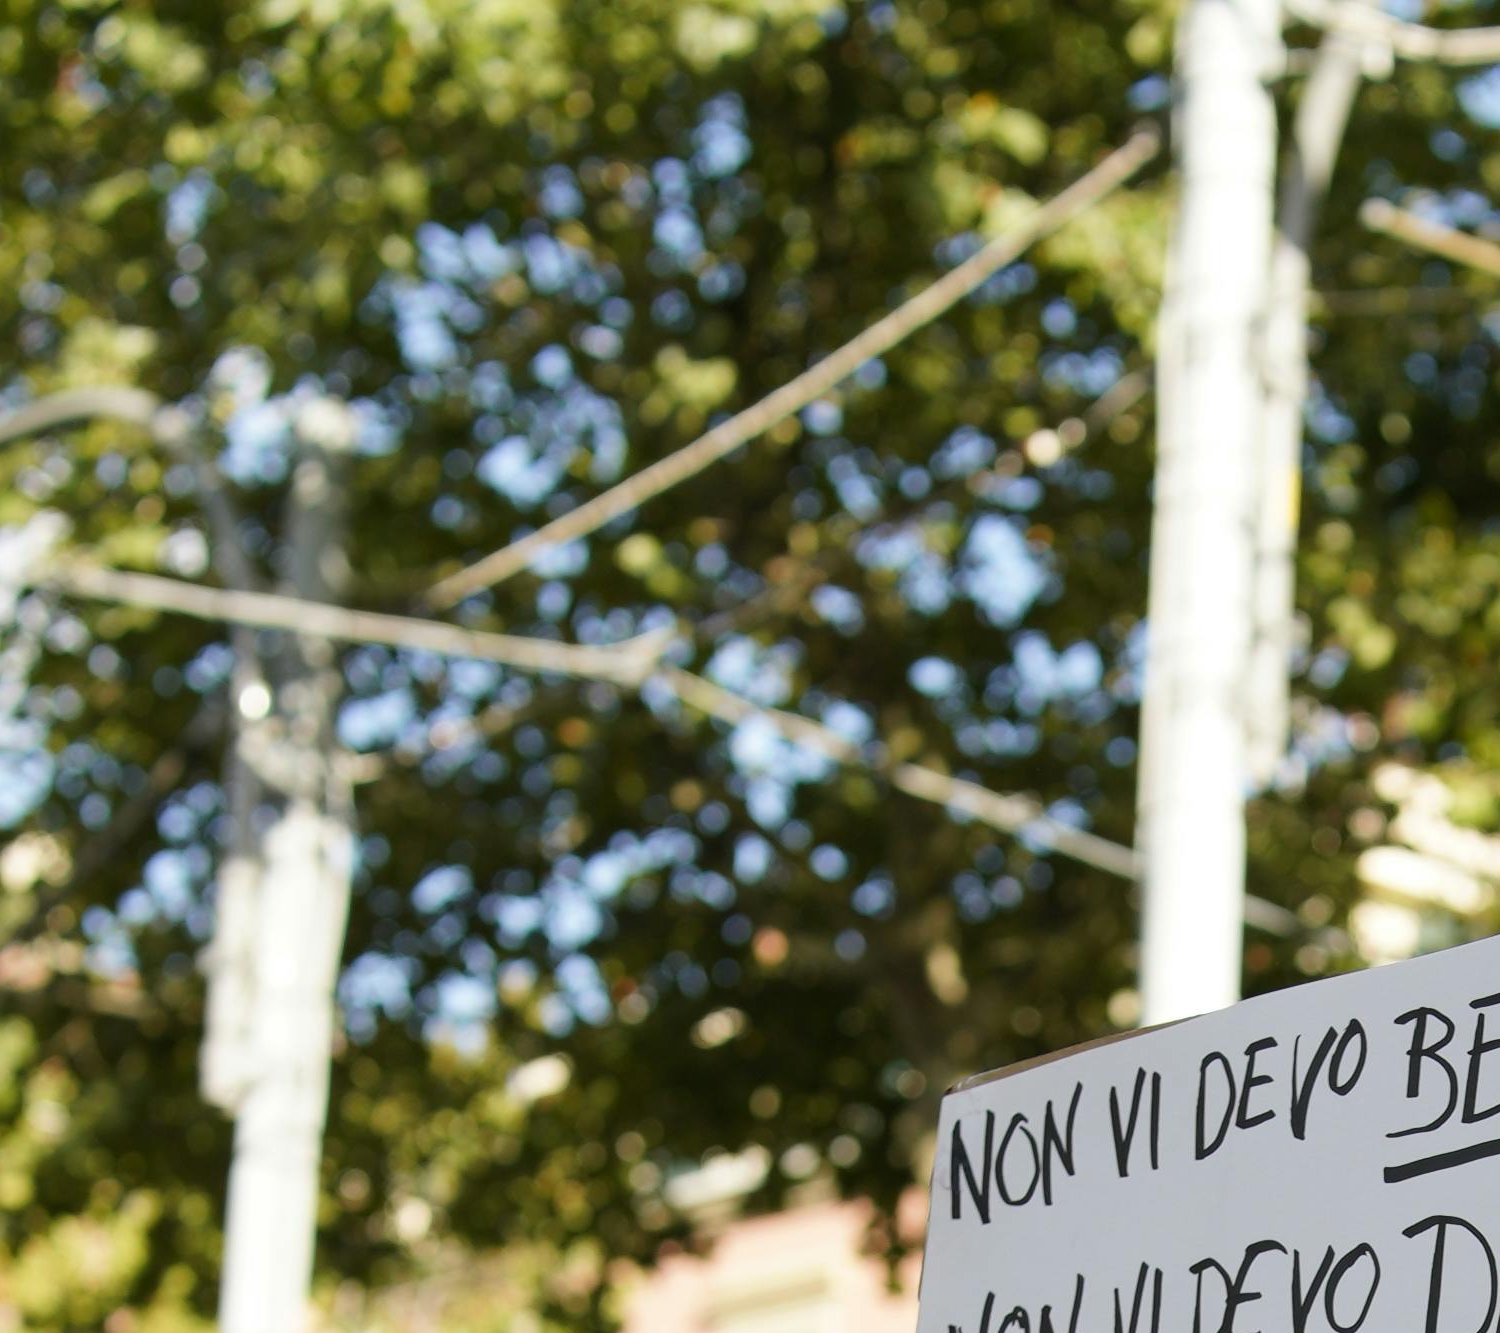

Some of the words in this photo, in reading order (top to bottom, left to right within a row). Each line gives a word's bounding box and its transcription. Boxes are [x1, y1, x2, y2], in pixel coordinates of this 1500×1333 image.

[949, 1080, 1084, 1226] NON
[1108, 1065, 1163, 1179] VI
[1193, 1017, 1369, 1162] DEVO
